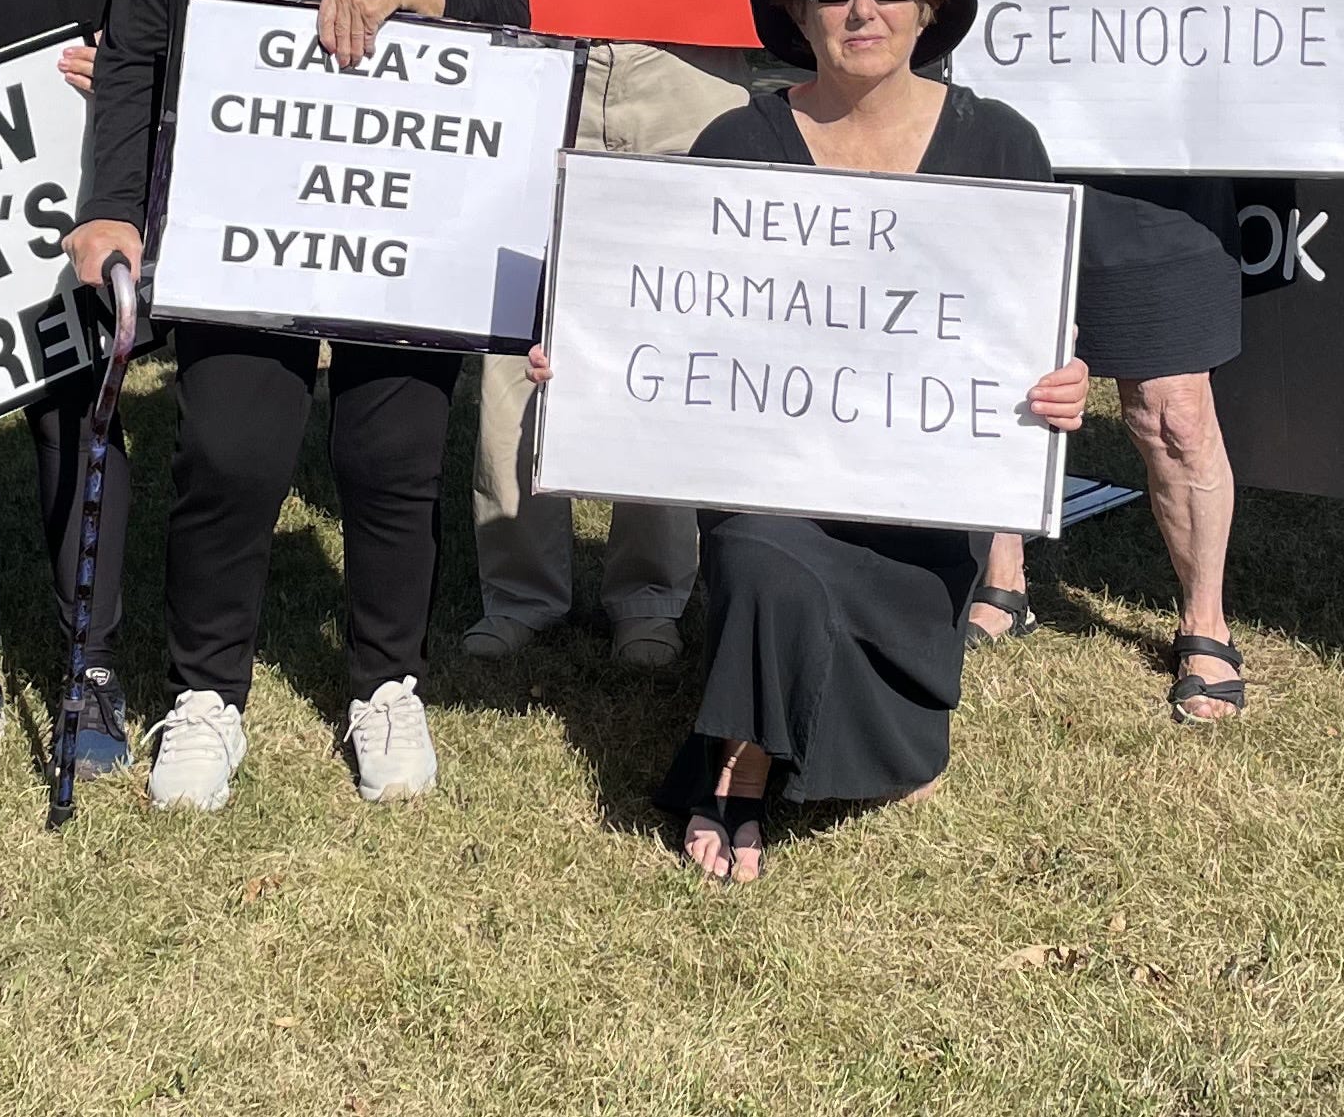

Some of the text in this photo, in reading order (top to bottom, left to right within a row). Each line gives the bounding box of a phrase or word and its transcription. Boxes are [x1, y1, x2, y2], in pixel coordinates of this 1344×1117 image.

[984, 1, 1327, 67] GENOCIDE
[210, 95, 503, 158] CHILDREN
[299, 165, 412, 210] ARE
[221, 225, 409, 278] DYING
[712, 196, 898, 252] NEVER
[1237, 204, 1329, 282] OK
[630, 263, 966, 340] NORMALIZE
[627, 343, 1002, 438] GENOCIDE
